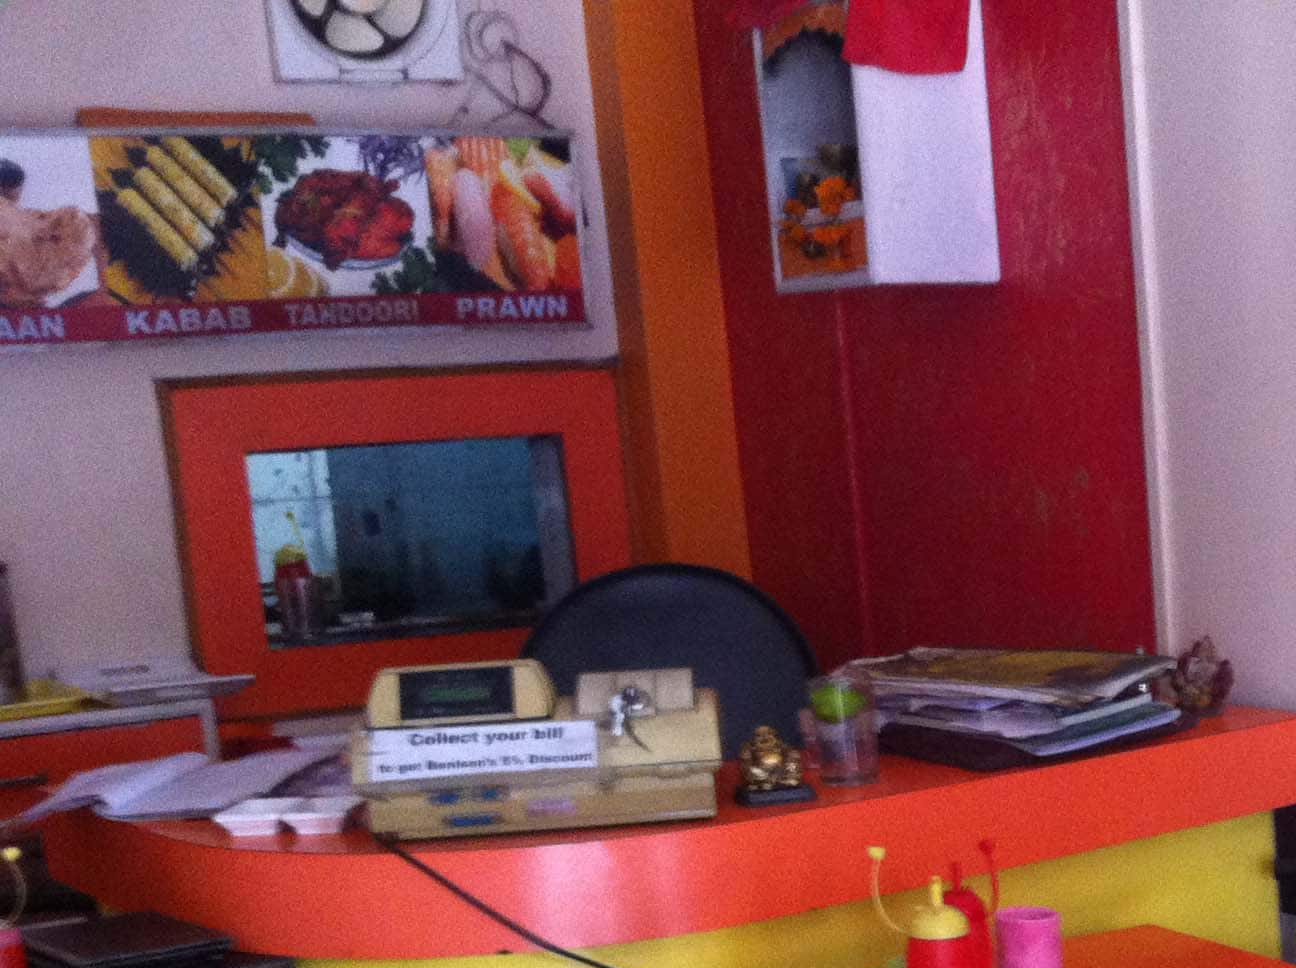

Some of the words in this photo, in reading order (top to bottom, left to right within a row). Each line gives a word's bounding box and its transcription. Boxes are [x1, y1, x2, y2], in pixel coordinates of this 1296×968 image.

[124, 305, 252, 335] KABAB
[284, 298, 420, 324] TANDOORI
[456, 295, 569, 320] PRAWN
[408, 732, 478, 746] Collect
[484, 730, 528, 745] your
[532, 726, 563, 740] bill
